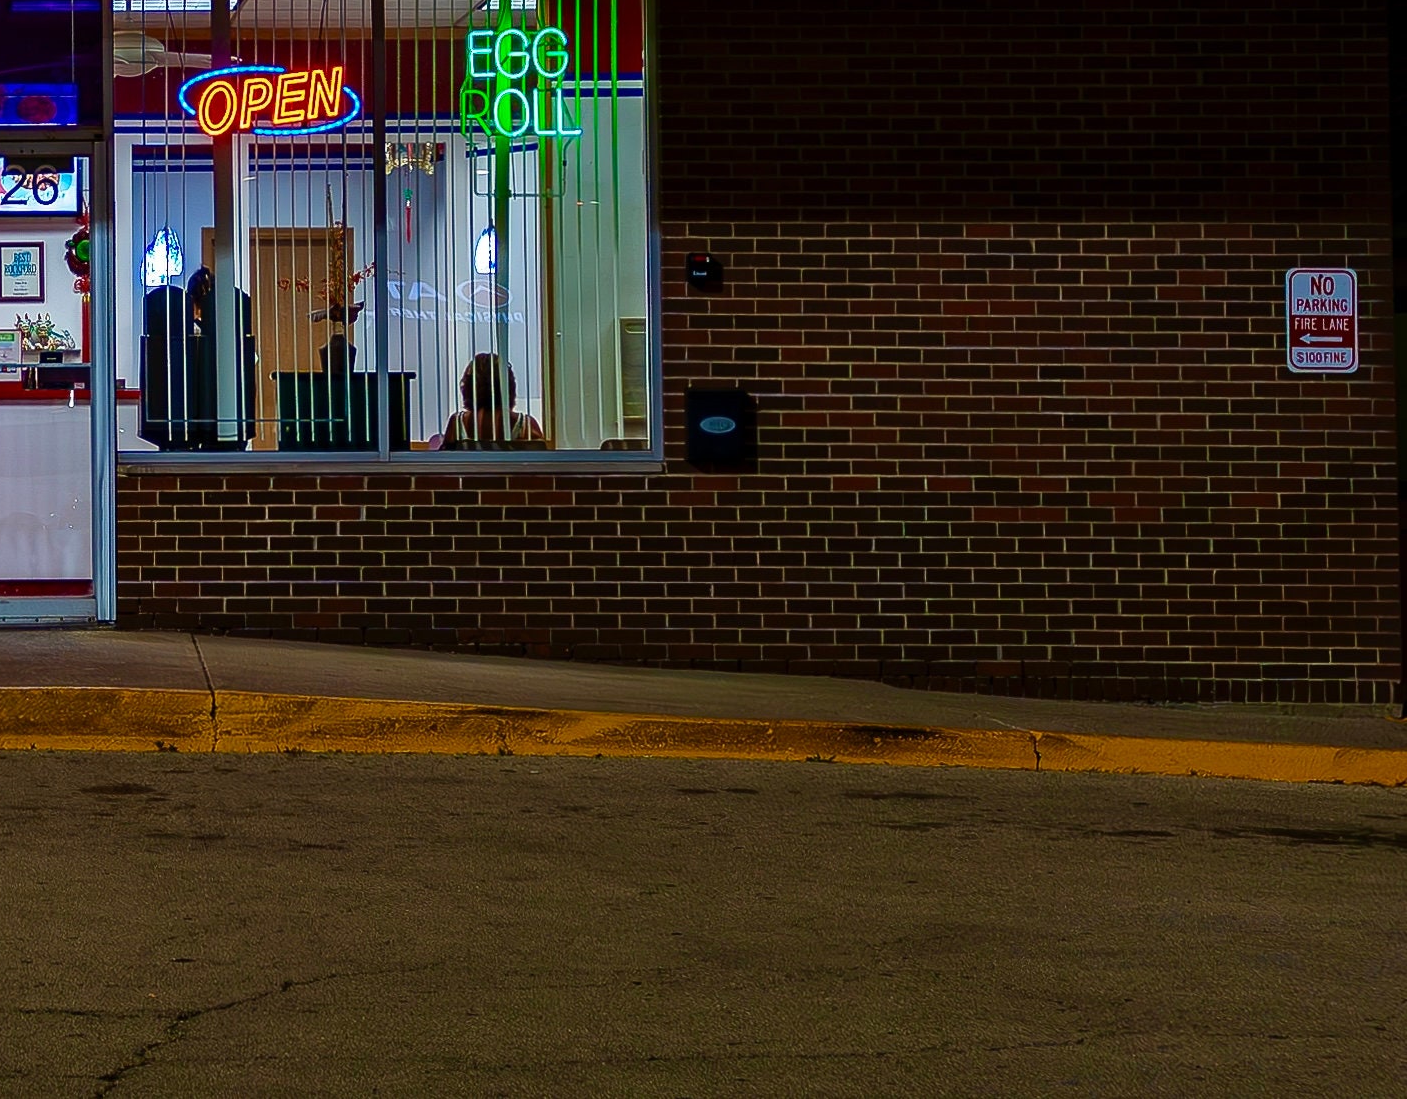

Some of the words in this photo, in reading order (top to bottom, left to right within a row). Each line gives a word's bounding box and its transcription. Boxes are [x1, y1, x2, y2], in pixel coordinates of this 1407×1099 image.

[468, 27, 569, 79] EGG
[198, 66, 343, 136] OPEN
[460, 88, 583, 137] ROLL
[1310, 276, 1335, 296] NO
[1296, 298, 1348, 312] PARKING
[1294, 317, 1318, 331] FIRE
[1322, 318, 1350, 331] LANE
[1324, 351, 1347, 363] FINE
